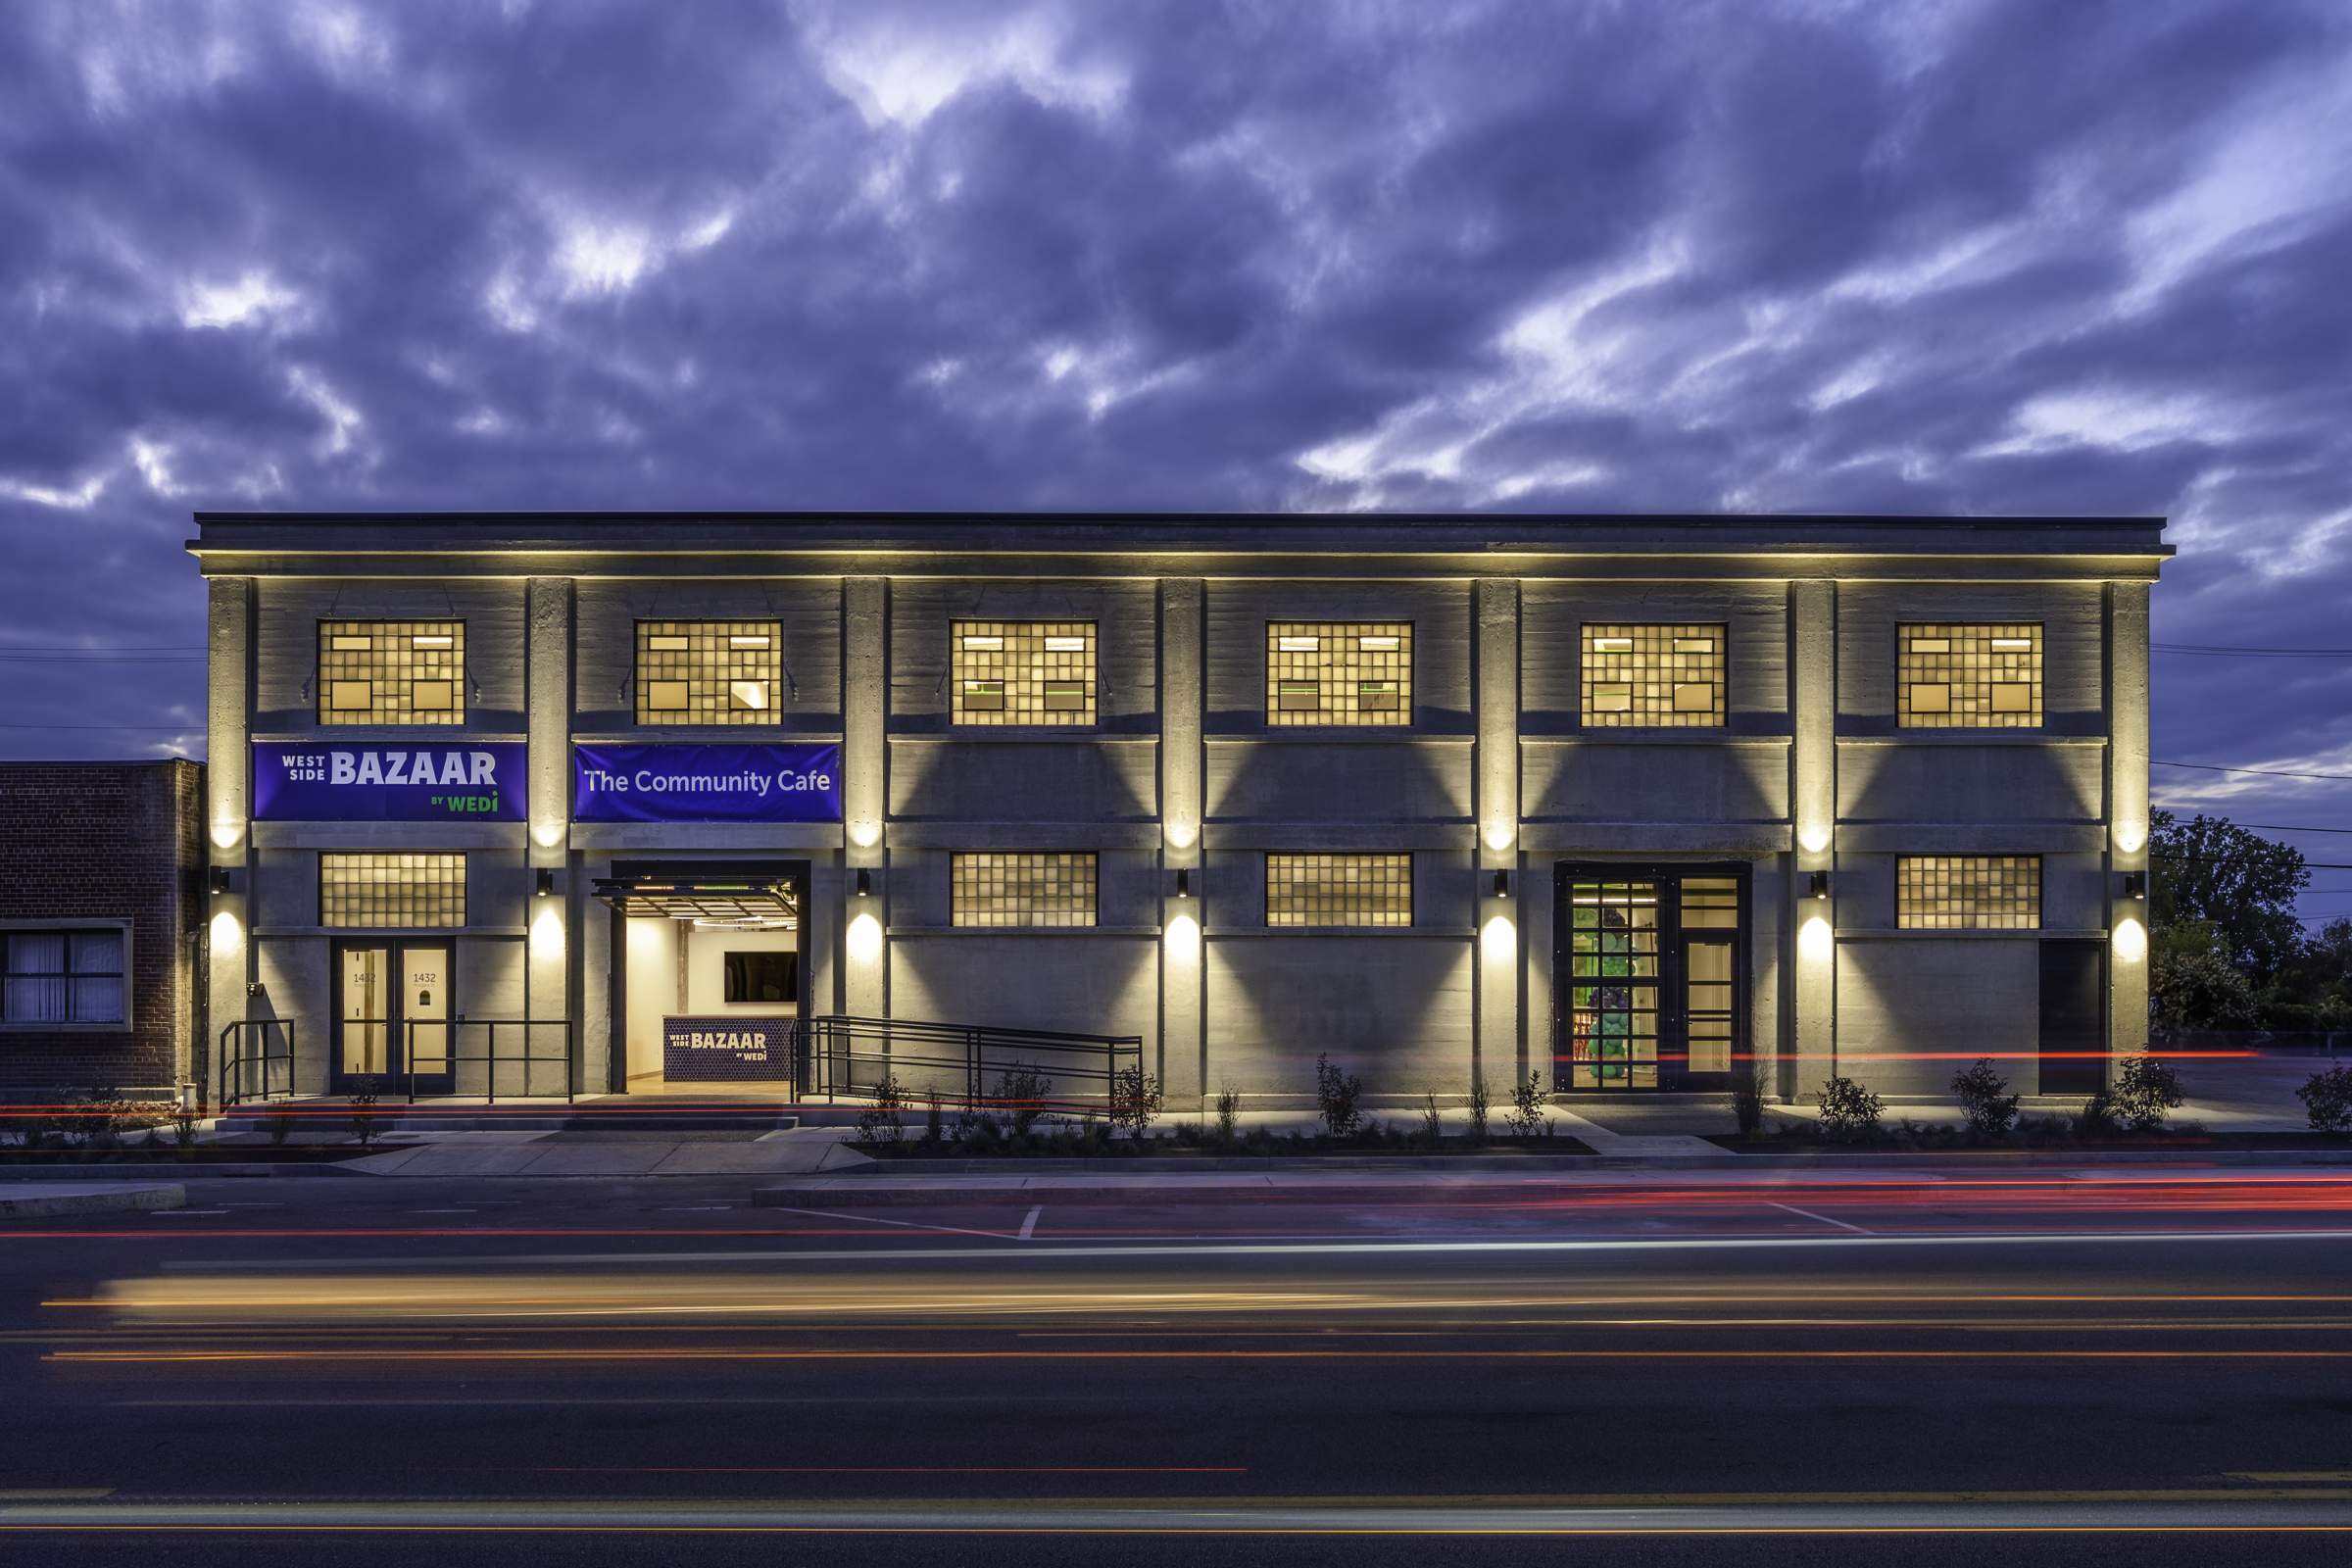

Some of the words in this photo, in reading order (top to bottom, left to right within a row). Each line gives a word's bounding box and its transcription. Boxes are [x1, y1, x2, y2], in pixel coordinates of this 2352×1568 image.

[282, 756, 325, 767] WEST
[330, 752, 498, 784] BAZAAR
[290, 769, 325, 780] SIDE
[584, 770, 628, 792] The
[636, 770, 771, 797] Community
[777, 769, 831, 791] Cafe
[414, 973, 436, 983] 1432
[691, 1033, 766, 1049] BAZAAR
